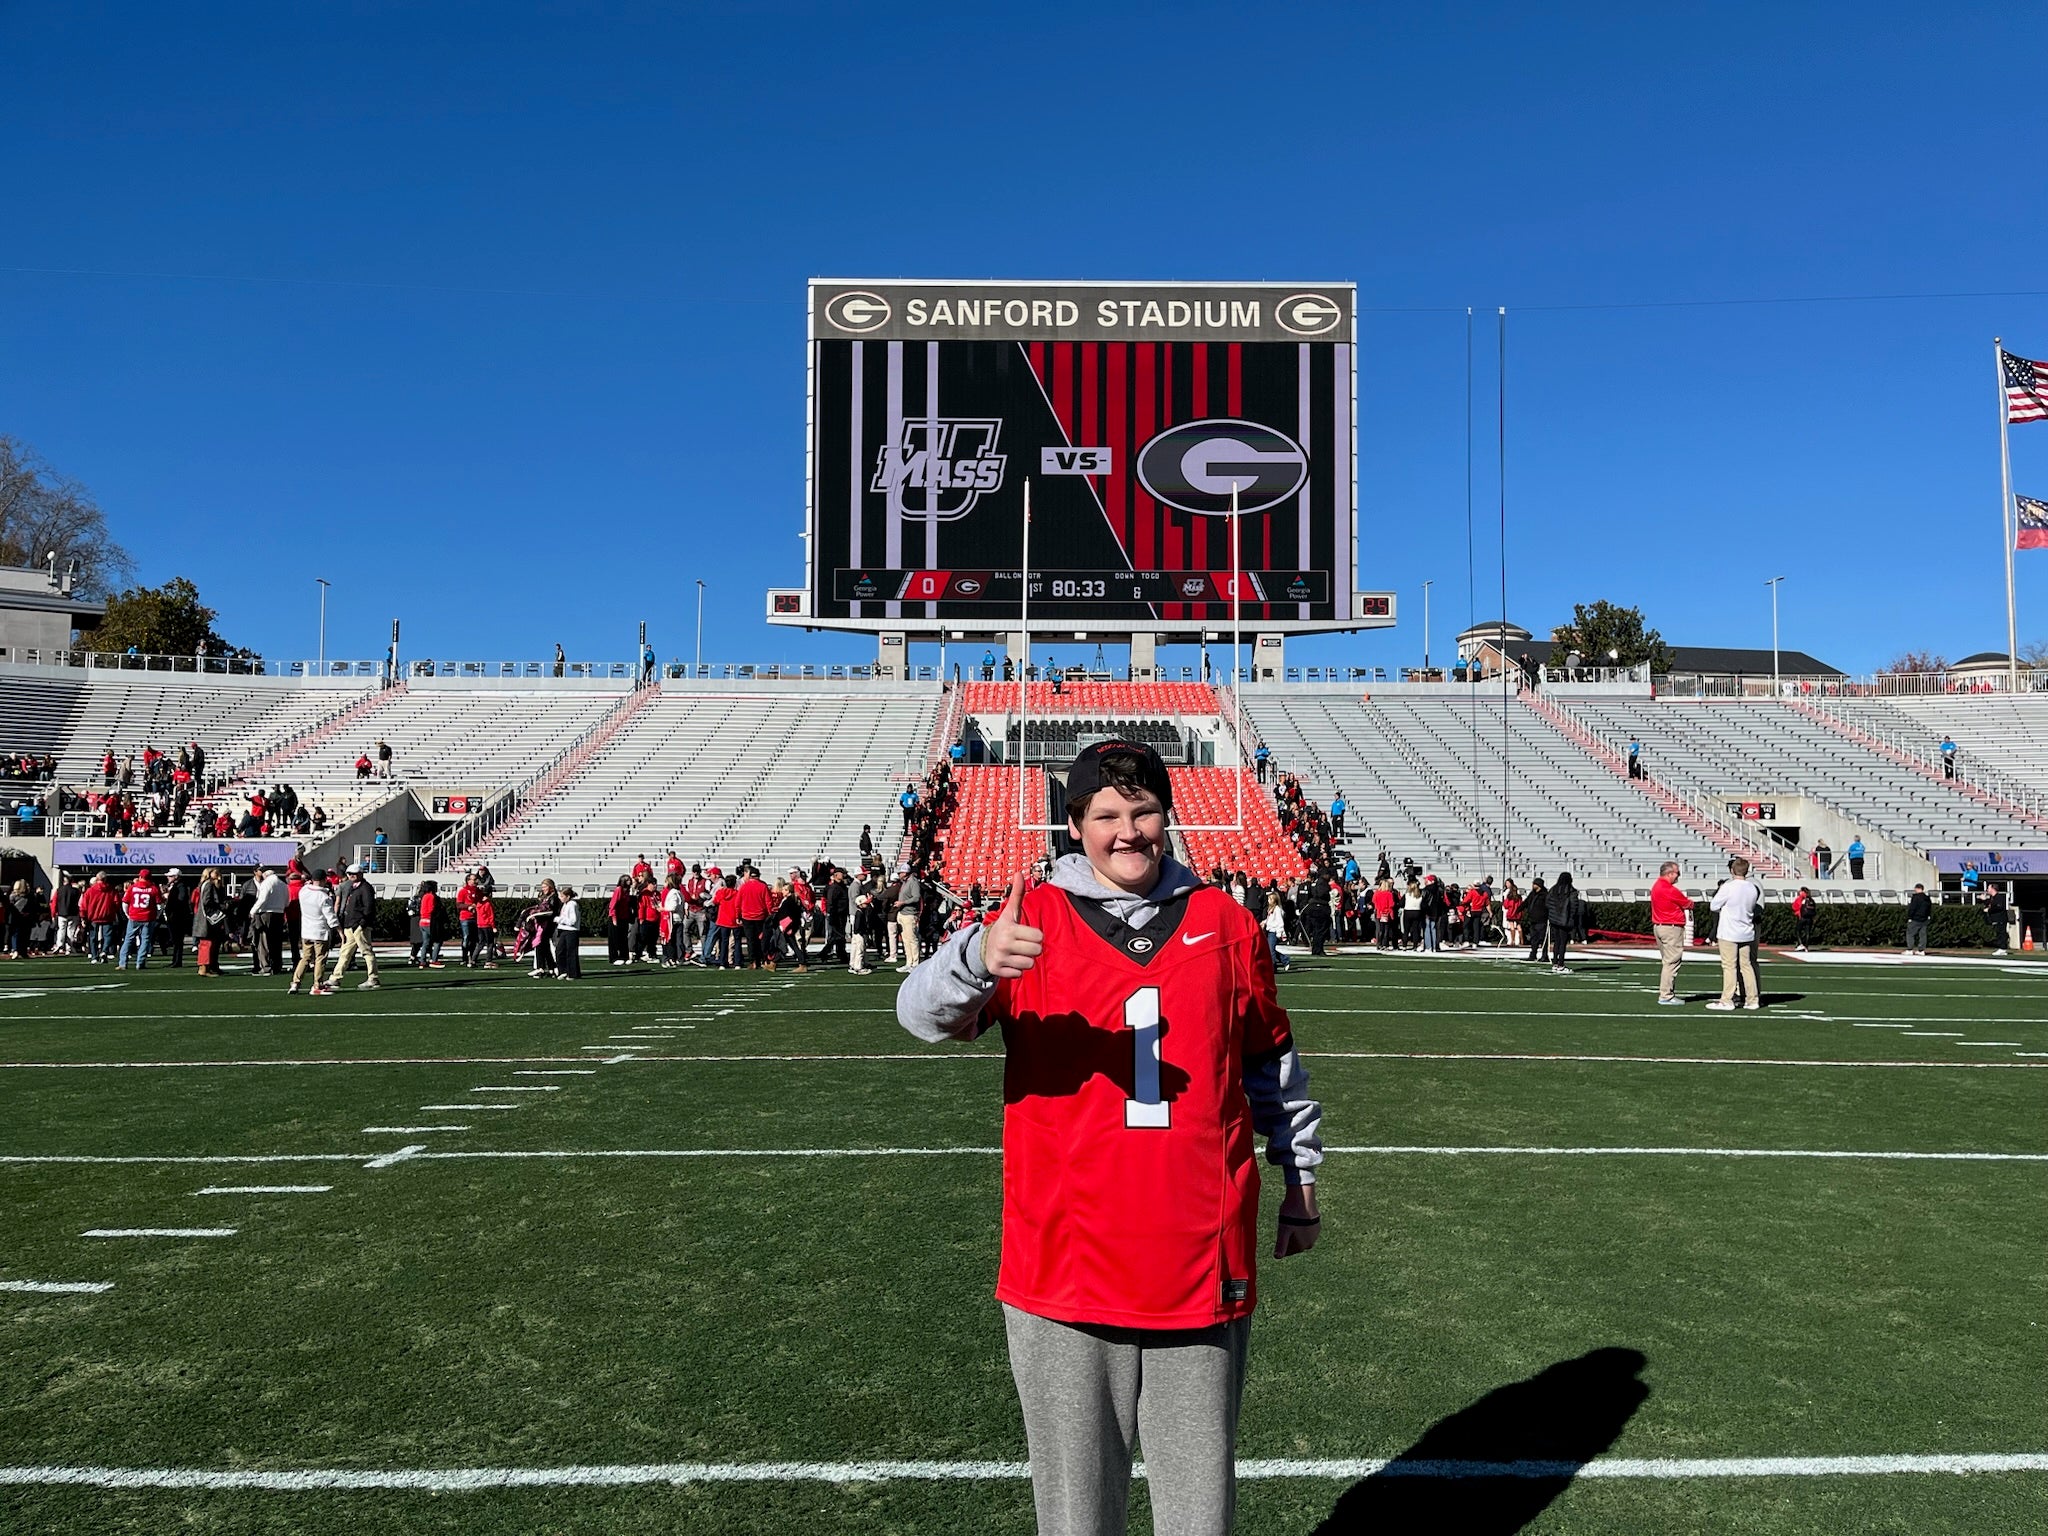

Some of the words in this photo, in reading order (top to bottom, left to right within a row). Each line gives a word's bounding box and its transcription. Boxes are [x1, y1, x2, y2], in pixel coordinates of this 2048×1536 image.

[906, 299, 1079, 327] SANFORD
[1097, 300, 1261, 328] STADIUM
[922, 577, 935, 595] 0
[1052, 580, 1106, 597] 80:33
[1286, 586, 1310, 594] Georgia
[776, 595, 799, 613] 25
[1364, 598, 1387, 616] 25
[83, 853, 128, 864] Walton
[129, 853, 155, 864] GAS
[186, 854, 232, 864] Walton
[233, 854, 260, 864] GAS
[2004, 862, 2029, 873] GAS
[132, 893, 151, 908] 13
[1124, 985, 1172, 1129] 1
